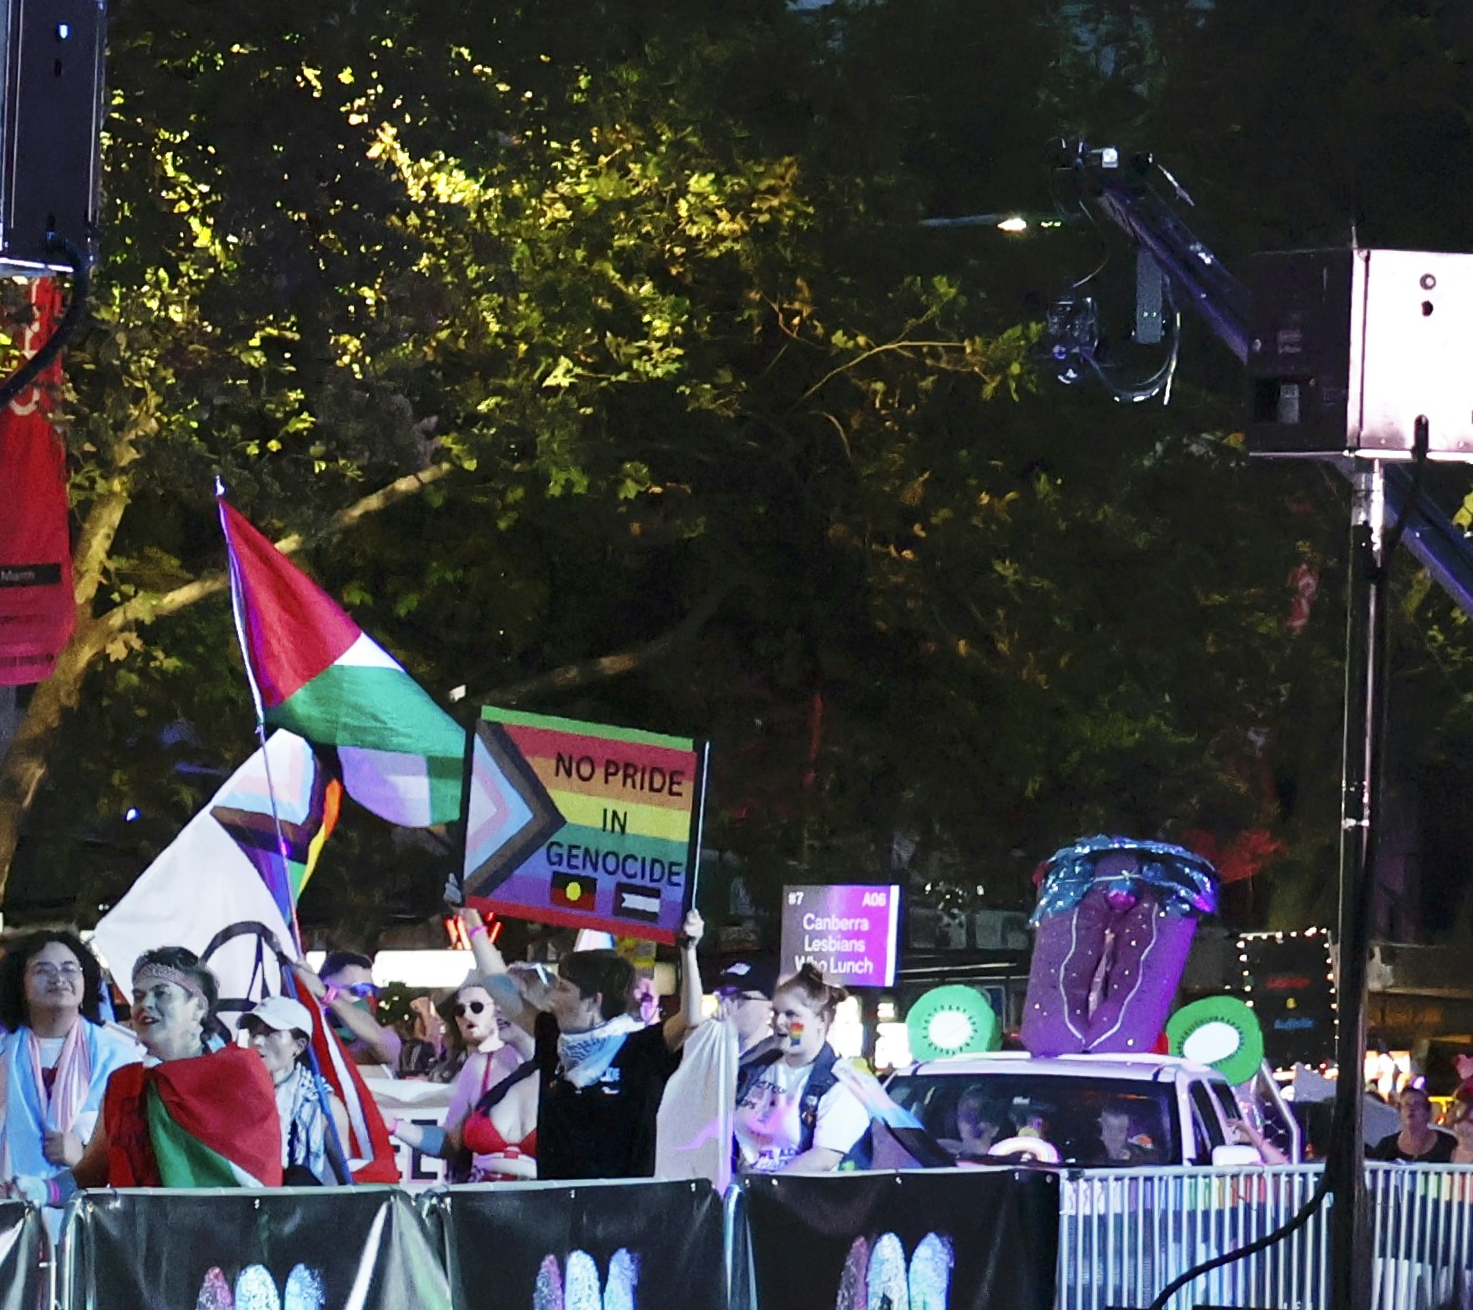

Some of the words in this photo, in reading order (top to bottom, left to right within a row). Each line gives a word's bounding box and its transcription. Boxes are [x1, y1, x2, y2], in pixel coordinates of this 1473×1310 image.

[555, 751, 596, 782] NO
[603, 759, 685, 798] PRIDE
[601, 807, 628, 836] IN
[545, 840, 683, 888] GENOCIDE
[787, 892, 805, 906] #7
[861, 892, 887, 908] A06
[802, 912, 870, 932] Canberra
[803, 934, 866, 953] Lesbians
[829, 956, 874, 975] Lunch
